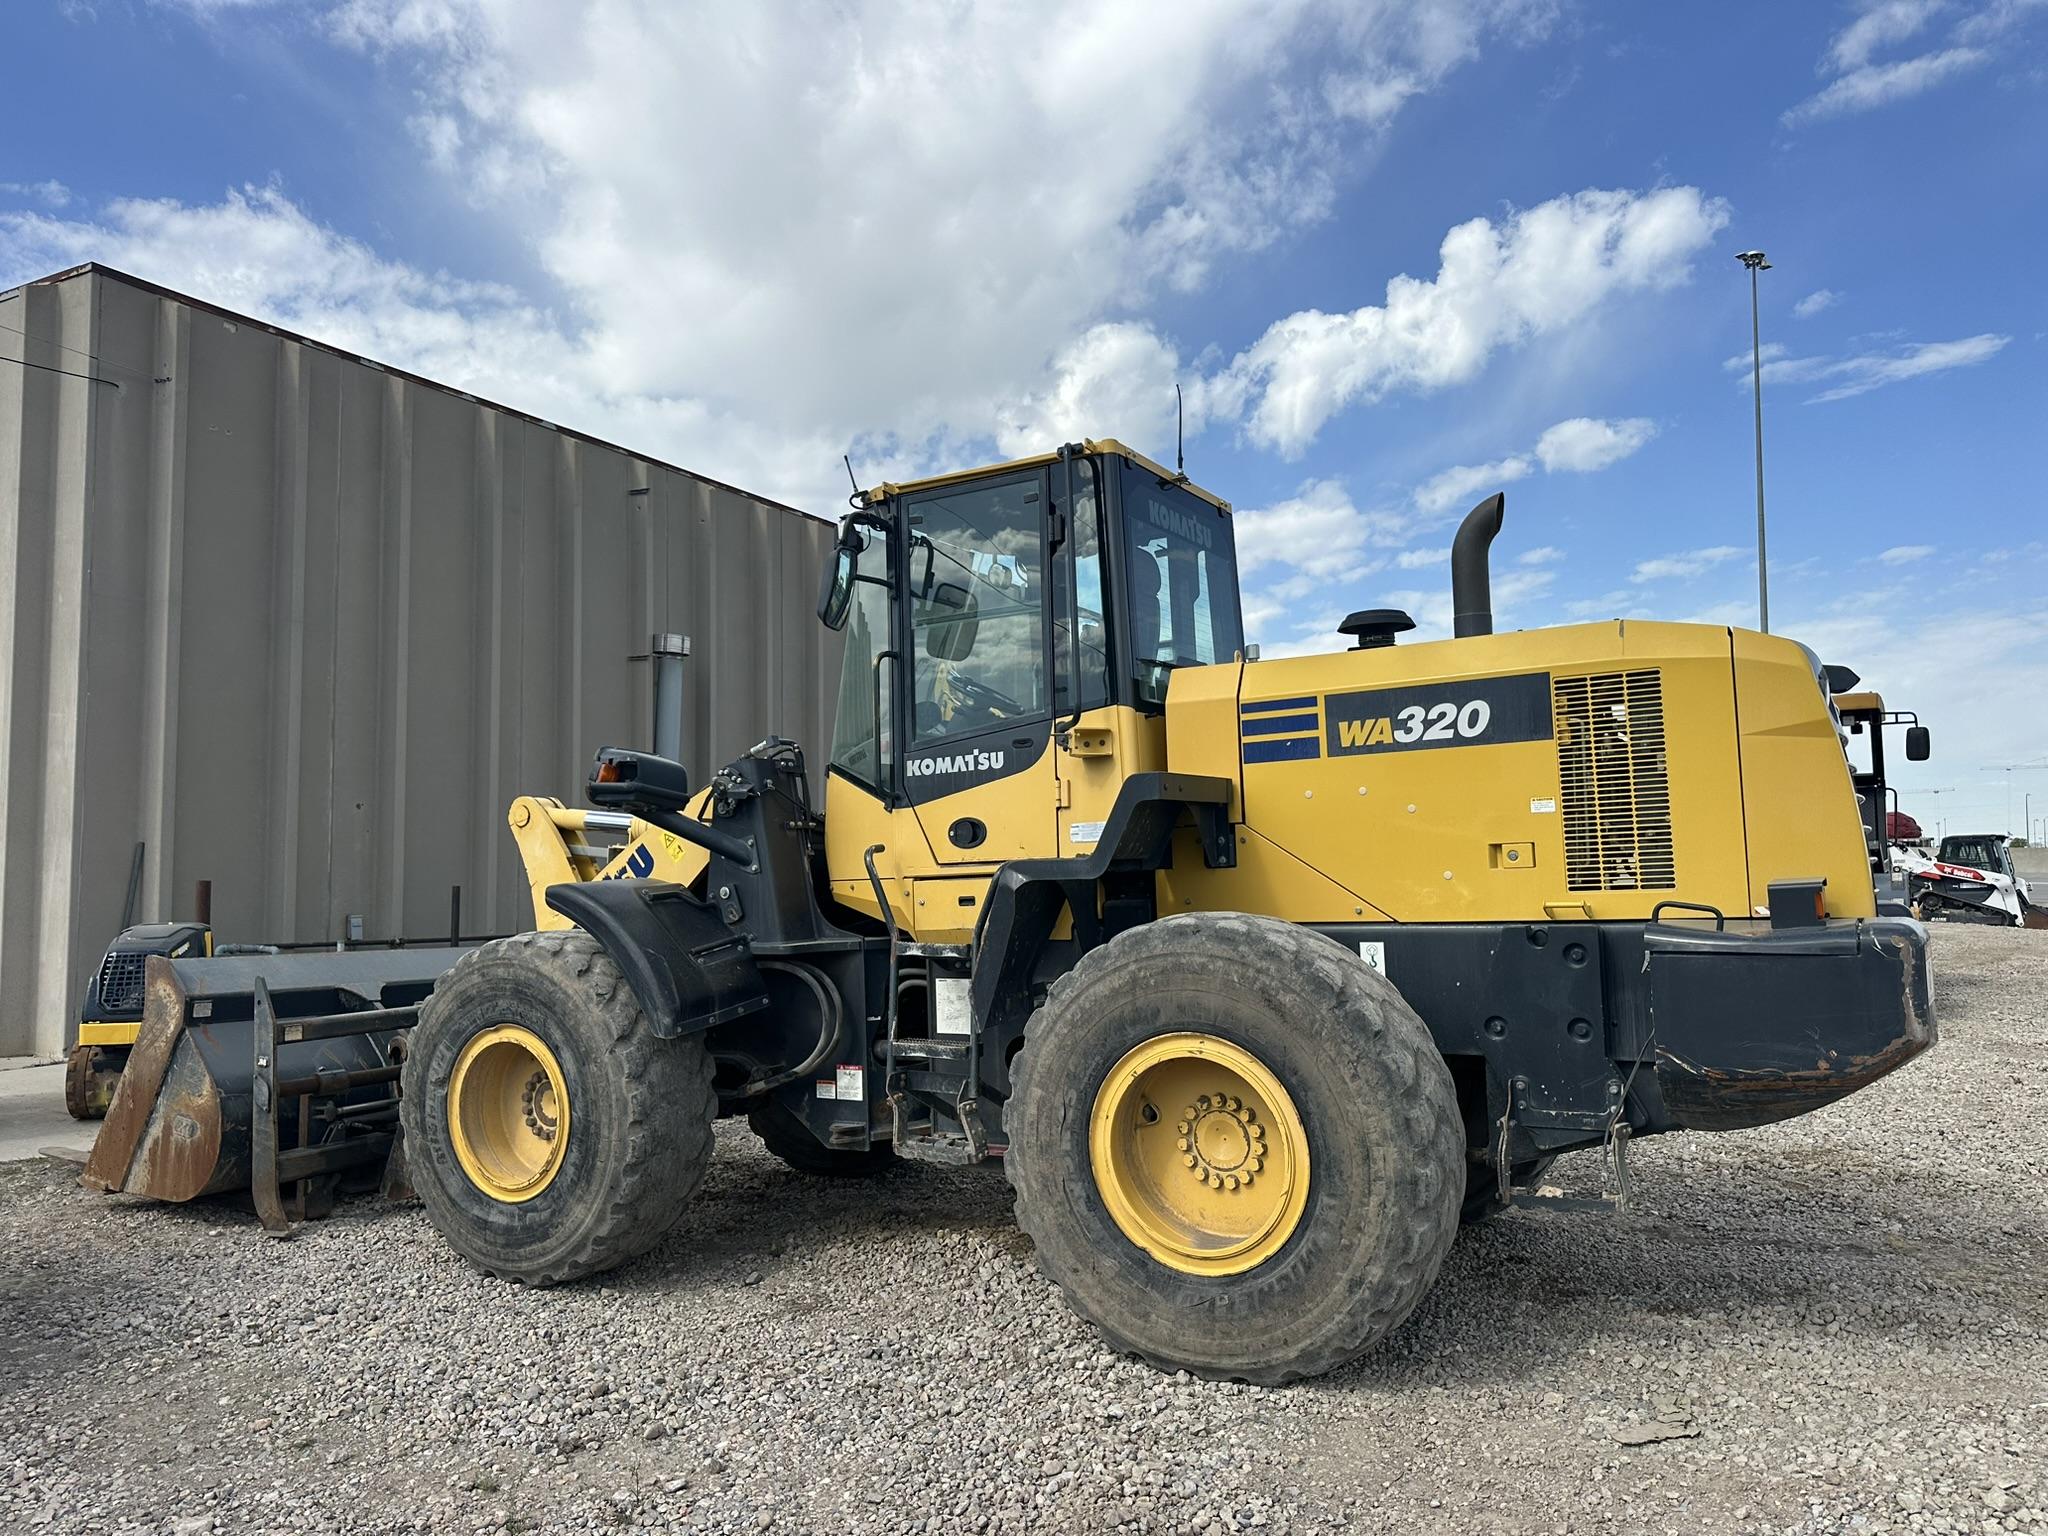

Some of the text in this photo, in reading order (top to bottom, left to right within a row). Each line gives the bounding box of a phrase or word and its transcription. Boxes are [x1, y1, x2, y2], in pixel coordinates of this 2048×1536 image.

[1148, 499, 1212, 549] KOMATSU
[1338, 699, 1491, 748] WA320
[906, 748, 1004, 777] KOMATSU
[1953, 868, 1974, 879] Bobcat
